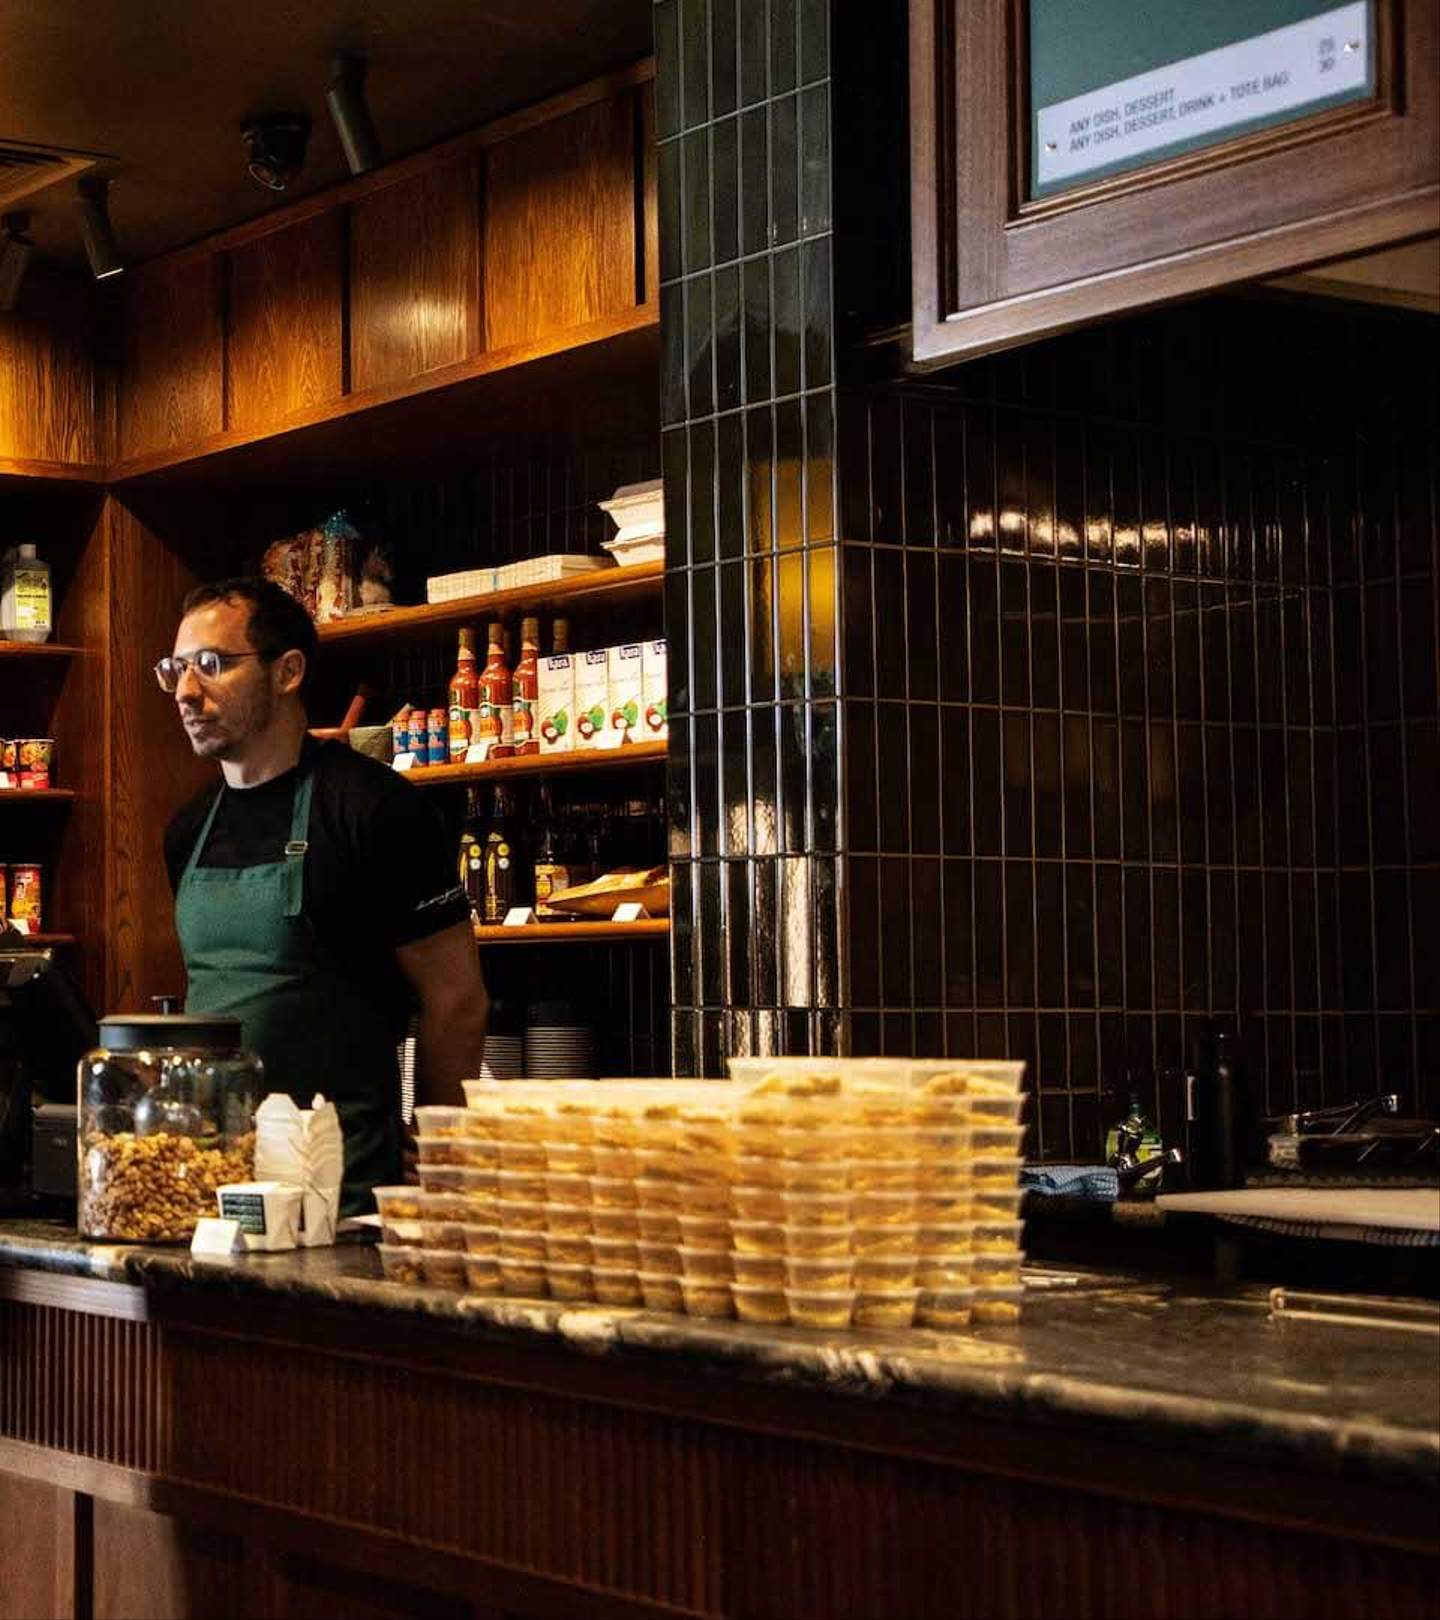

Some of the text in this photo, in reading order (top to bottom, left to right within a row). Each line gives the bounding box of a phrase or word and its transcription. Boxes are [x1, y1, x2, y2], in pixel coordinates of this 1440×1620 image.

[1069, 119, 1091, 134] ANY
[1124, 88, 1175, 115] DESSERT
[1069, 136, 1091, 151] ANY
[1179, 94, 1215, 118] DRINK
[1230, 78, 1260, 99] TOTE
[1263, 71, 1290, 90] BAG
